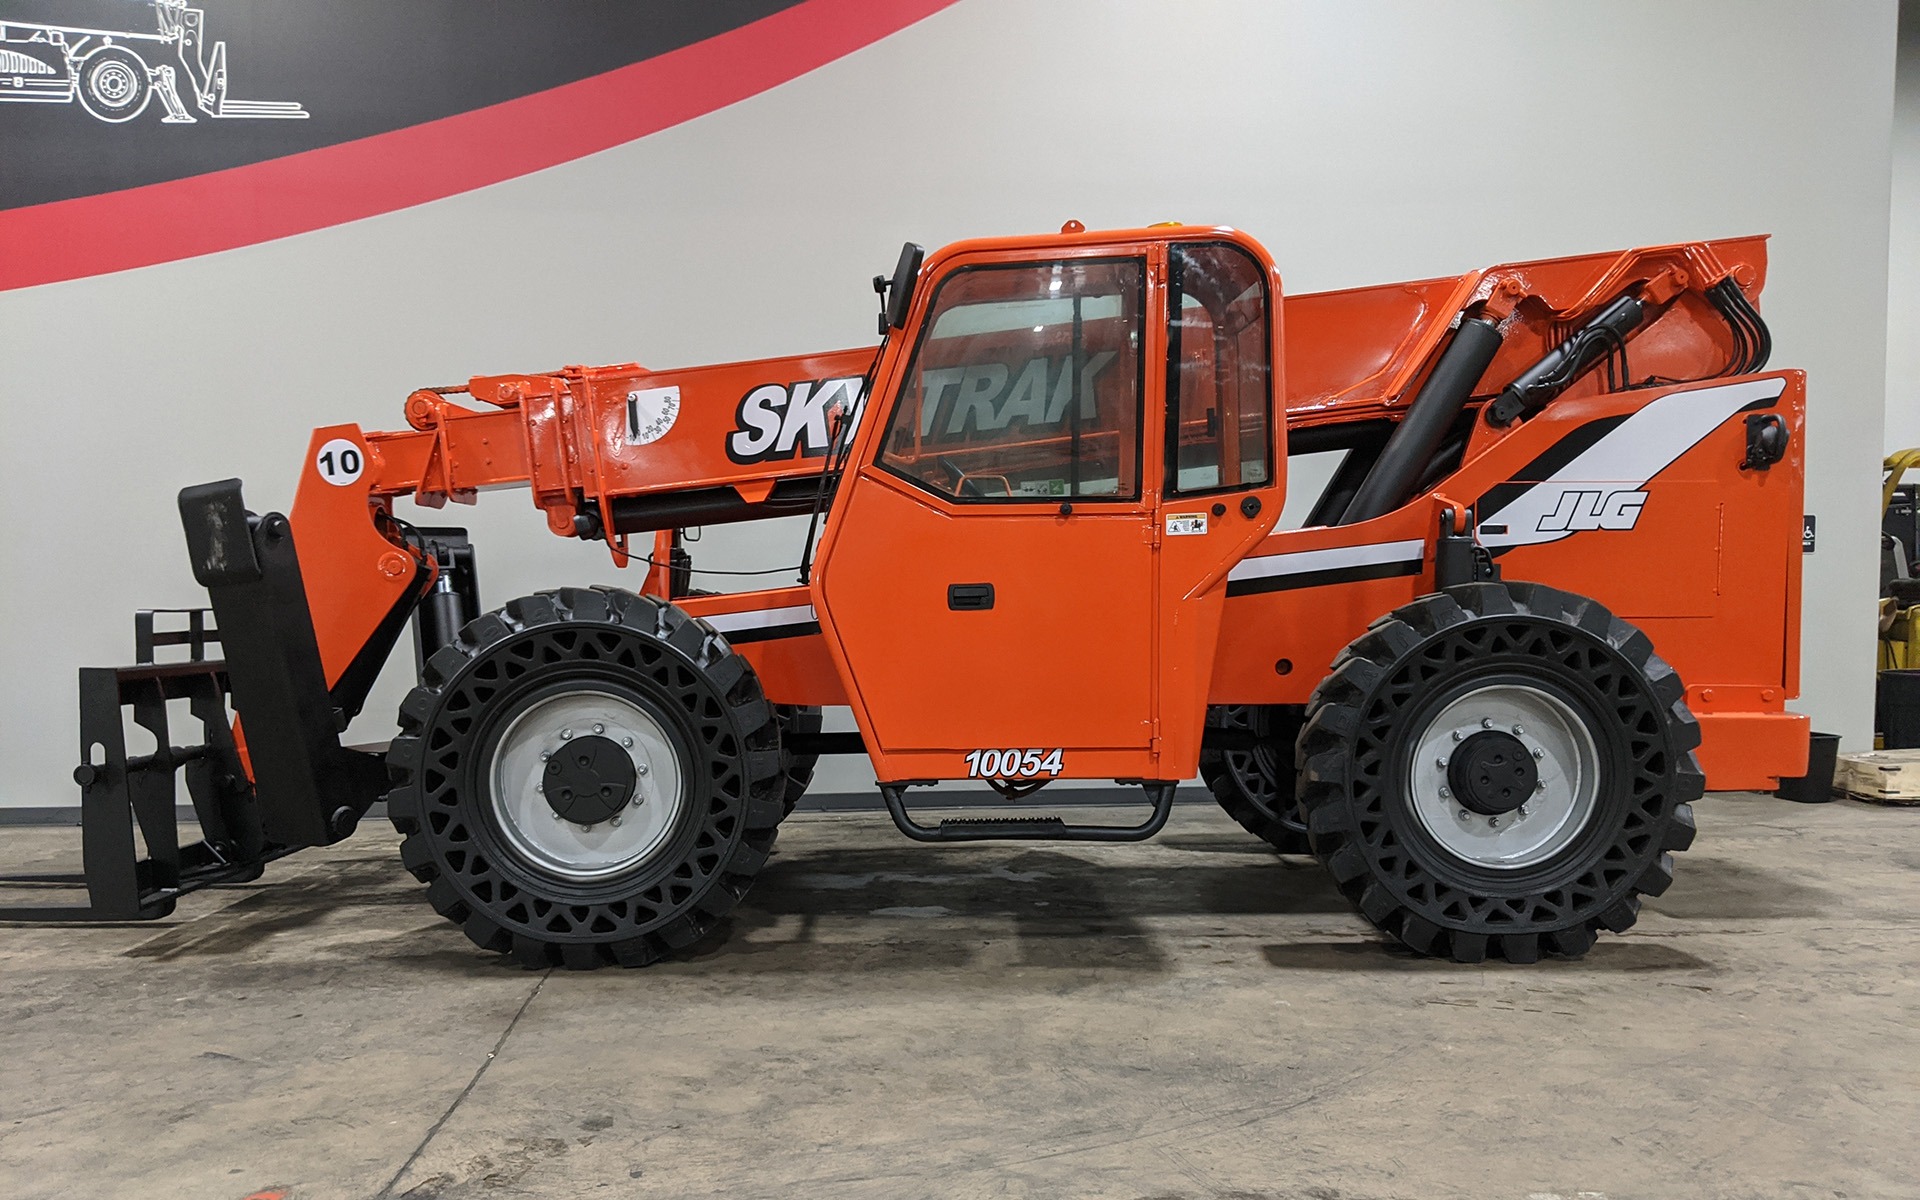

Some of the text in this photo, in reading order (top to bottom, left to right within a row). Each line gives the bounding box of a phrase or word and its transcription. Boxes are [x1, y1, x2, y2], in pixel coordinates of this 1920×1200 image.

[913, 351, 1118, 438] TRAK
[320, 450, 359, 476] 10
[1536, 490, 1650, 532] JLG
[965, 748, 1063, 777] 10054
